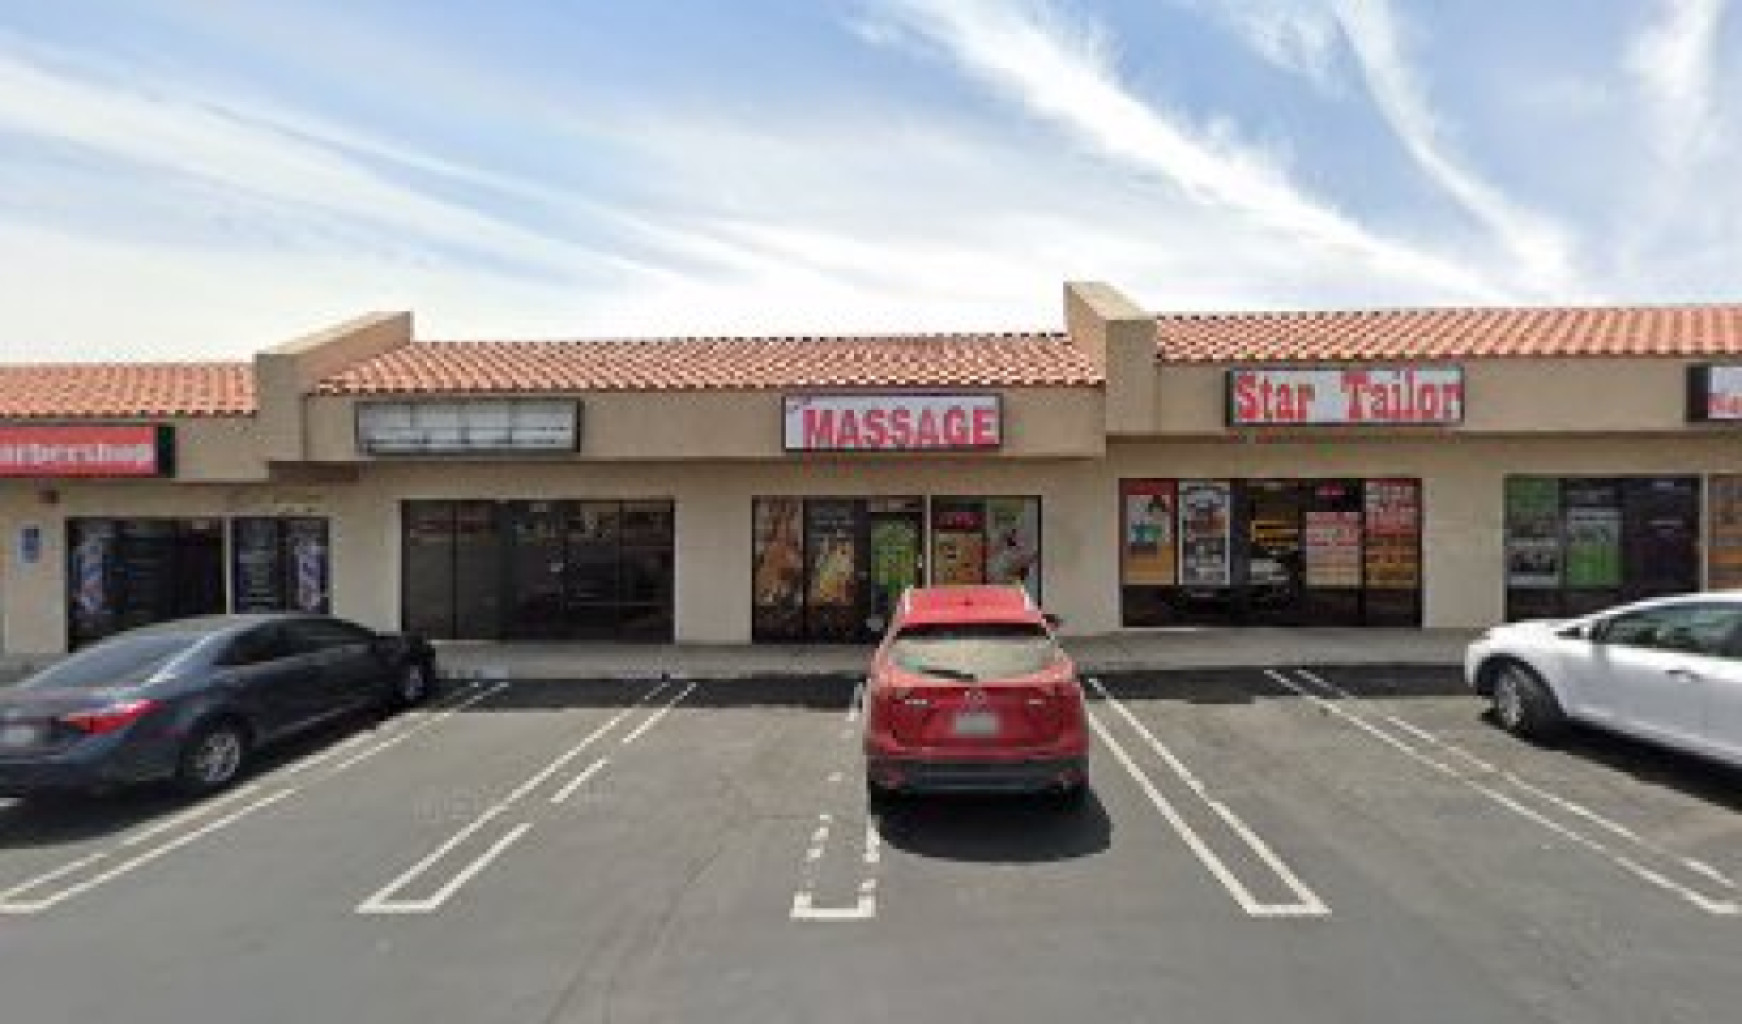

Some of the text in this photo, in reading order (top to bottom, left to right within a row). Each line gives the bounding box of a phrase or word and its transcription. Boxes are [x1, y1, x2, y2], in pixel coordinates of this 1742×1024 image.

[1237, 370, 1463, 419] Star Tailor
[802, 406, 998, 445] MASSAGE
